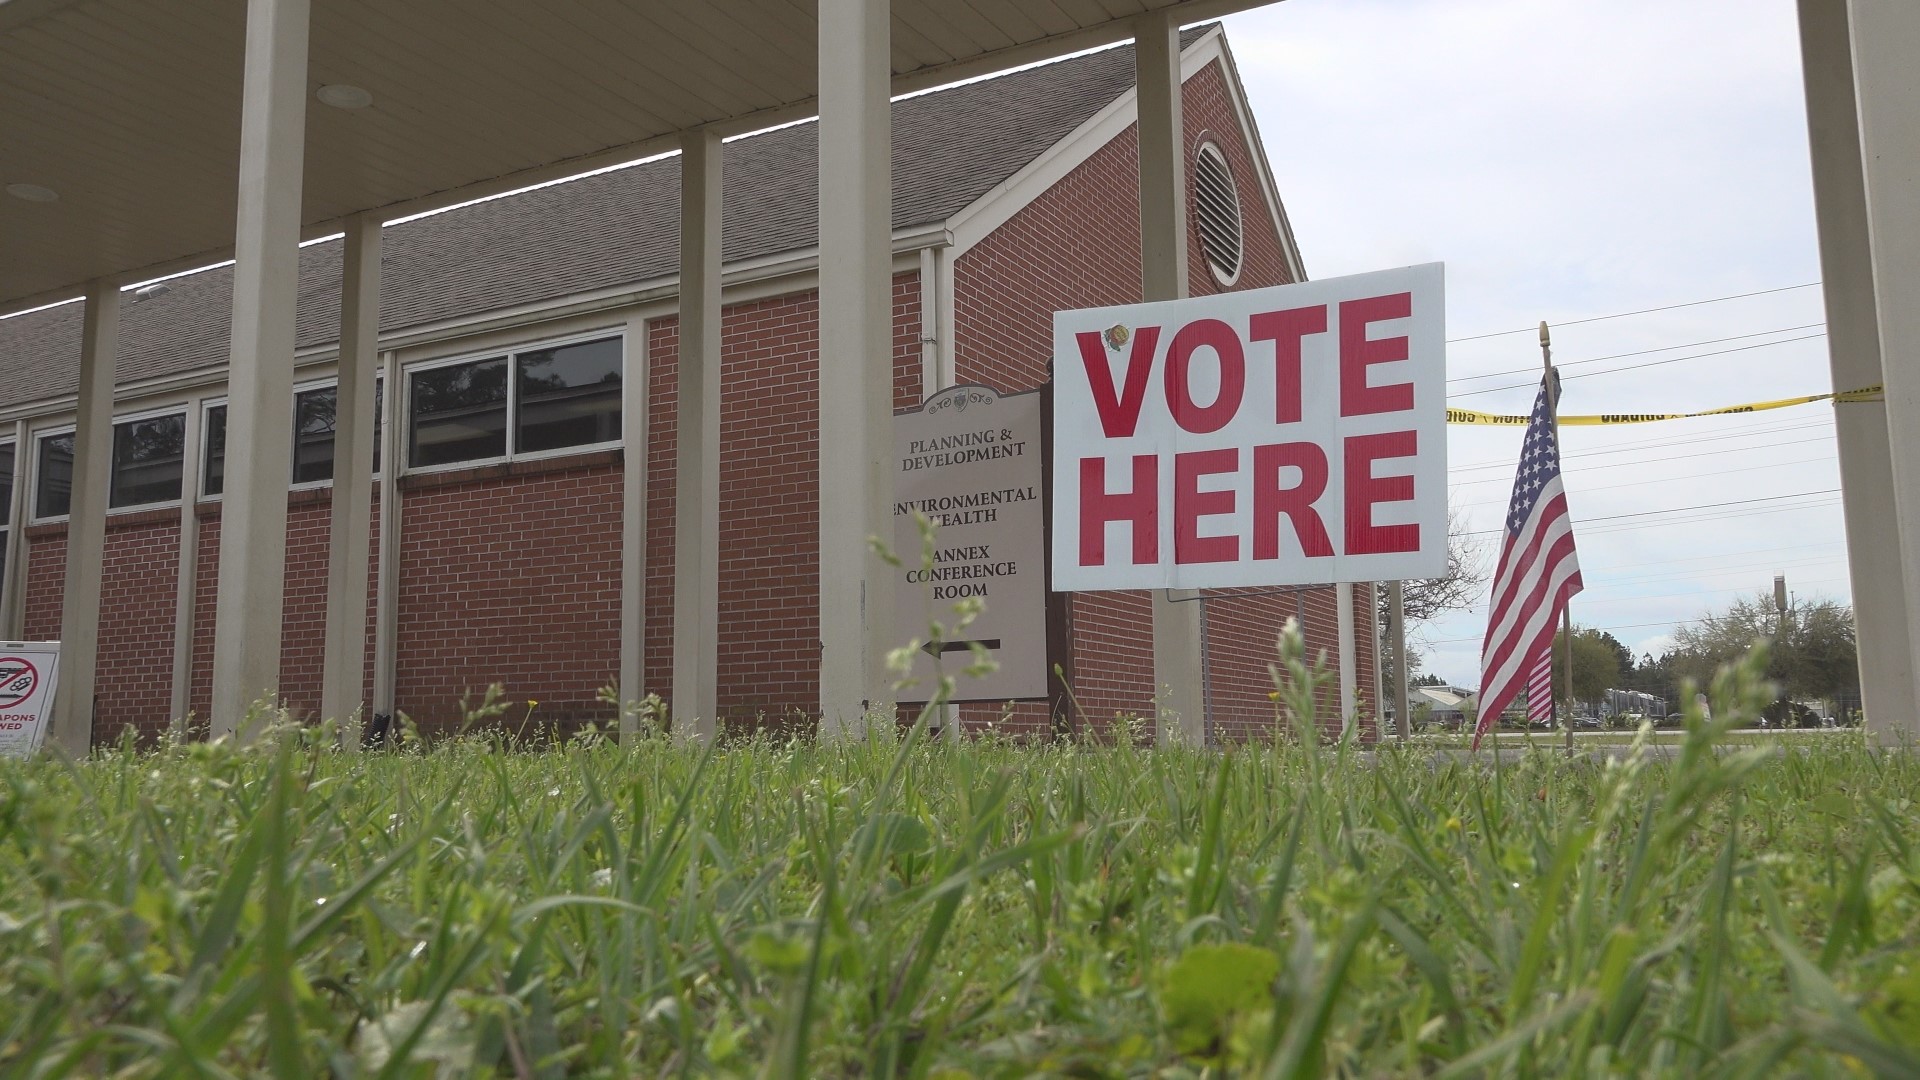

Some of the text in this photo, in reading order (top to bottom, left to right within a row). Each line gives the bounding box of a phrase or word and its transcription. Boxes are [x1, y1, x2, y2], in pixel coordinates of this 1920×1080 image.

[1075, 291, 1414, 438] VOTE
[910, 429, 1012, 454] PLANNING &
[902, 442, 1026, 471] DEVELOPMENT
[893, 487, 1037, 515] NVIRONMENTAL
[1079, 430, 1420, 566] HERE
[932, 545, 990, 563] ANNEX
[906, 562, 1017, 583] CONFERENCE
[933, 583, 988, 599] ROOM
